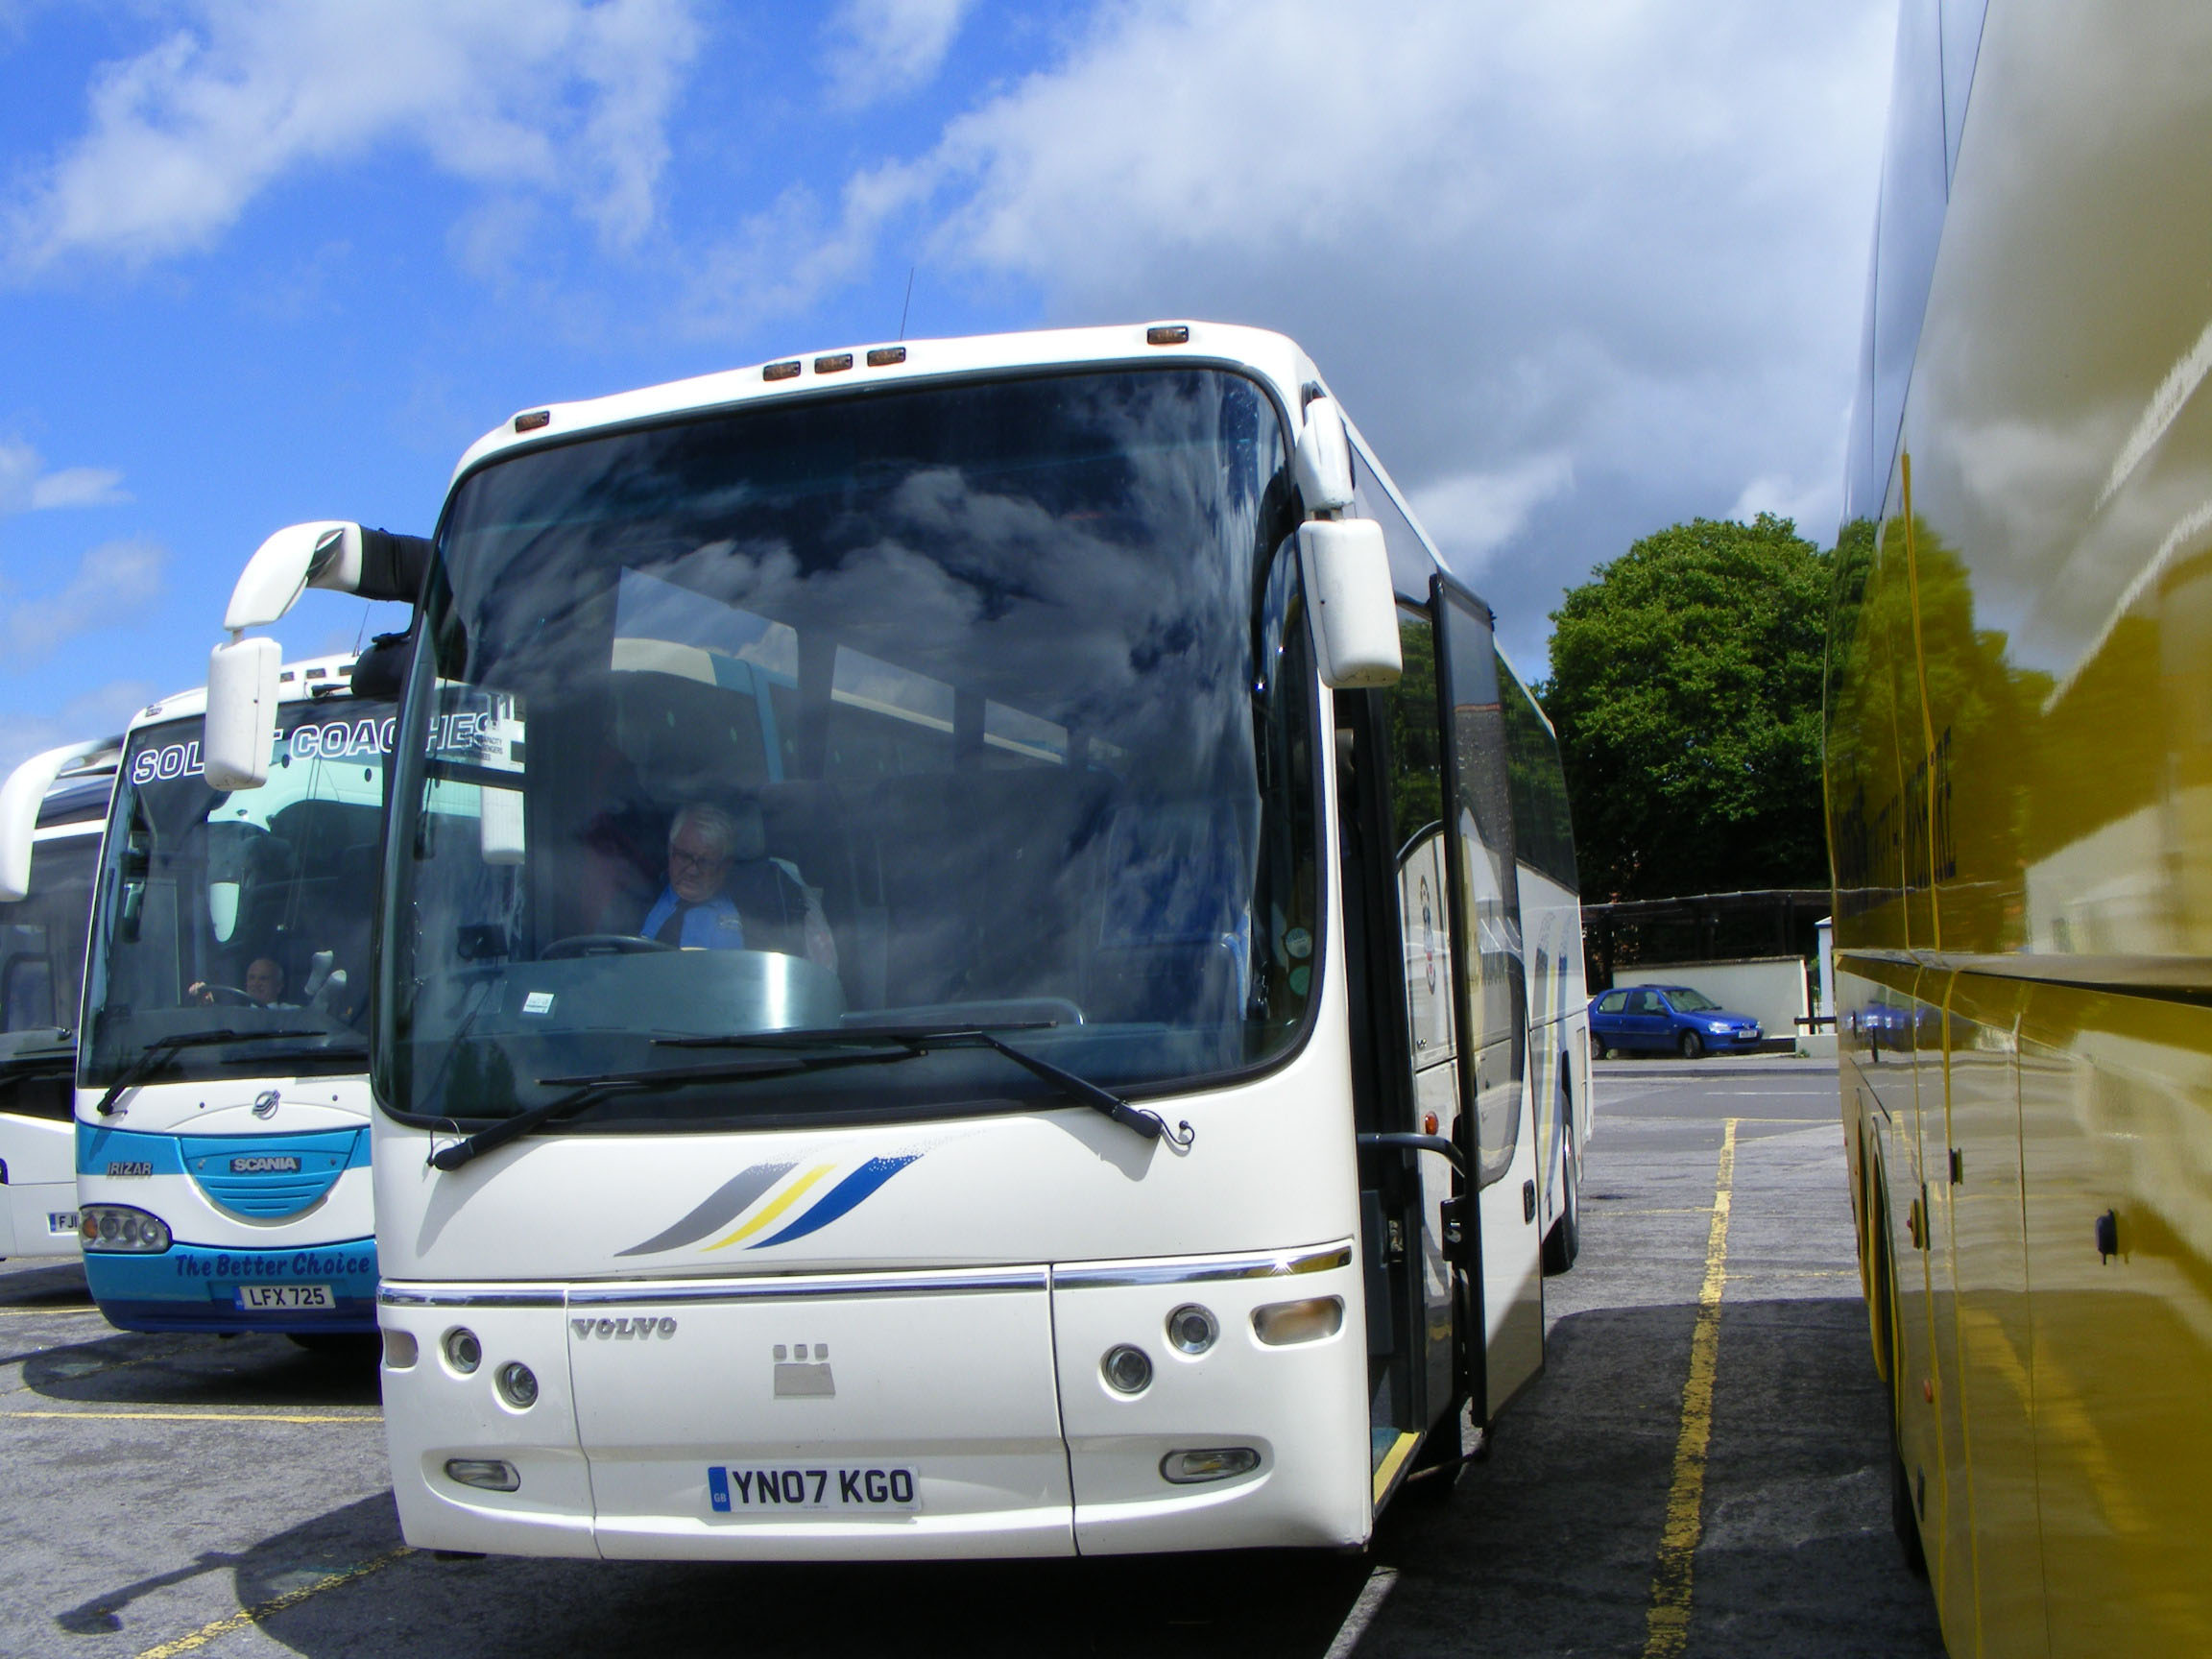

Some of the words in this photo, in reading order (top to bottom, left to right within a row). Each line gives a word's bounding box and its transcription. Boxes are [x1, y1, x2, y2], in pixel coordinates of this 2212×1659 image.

[107, 1162, 152, 1176] IRIZAR
[233, 1157, 297, 1171] SCANIA
[175, 1254, 211, 1276] The
[216, 1253, 287, 1276] Better
[292, 1252, 370, 1275] Choice
[249, 1288, 286, 1307] LFX
[289, 1287, 325, 1306] 725
[570, 1317, 678, 1335] VOLVO
[732, 1470, 828, 1504] YN07
[839, 1469, 914, 1503] KGO
